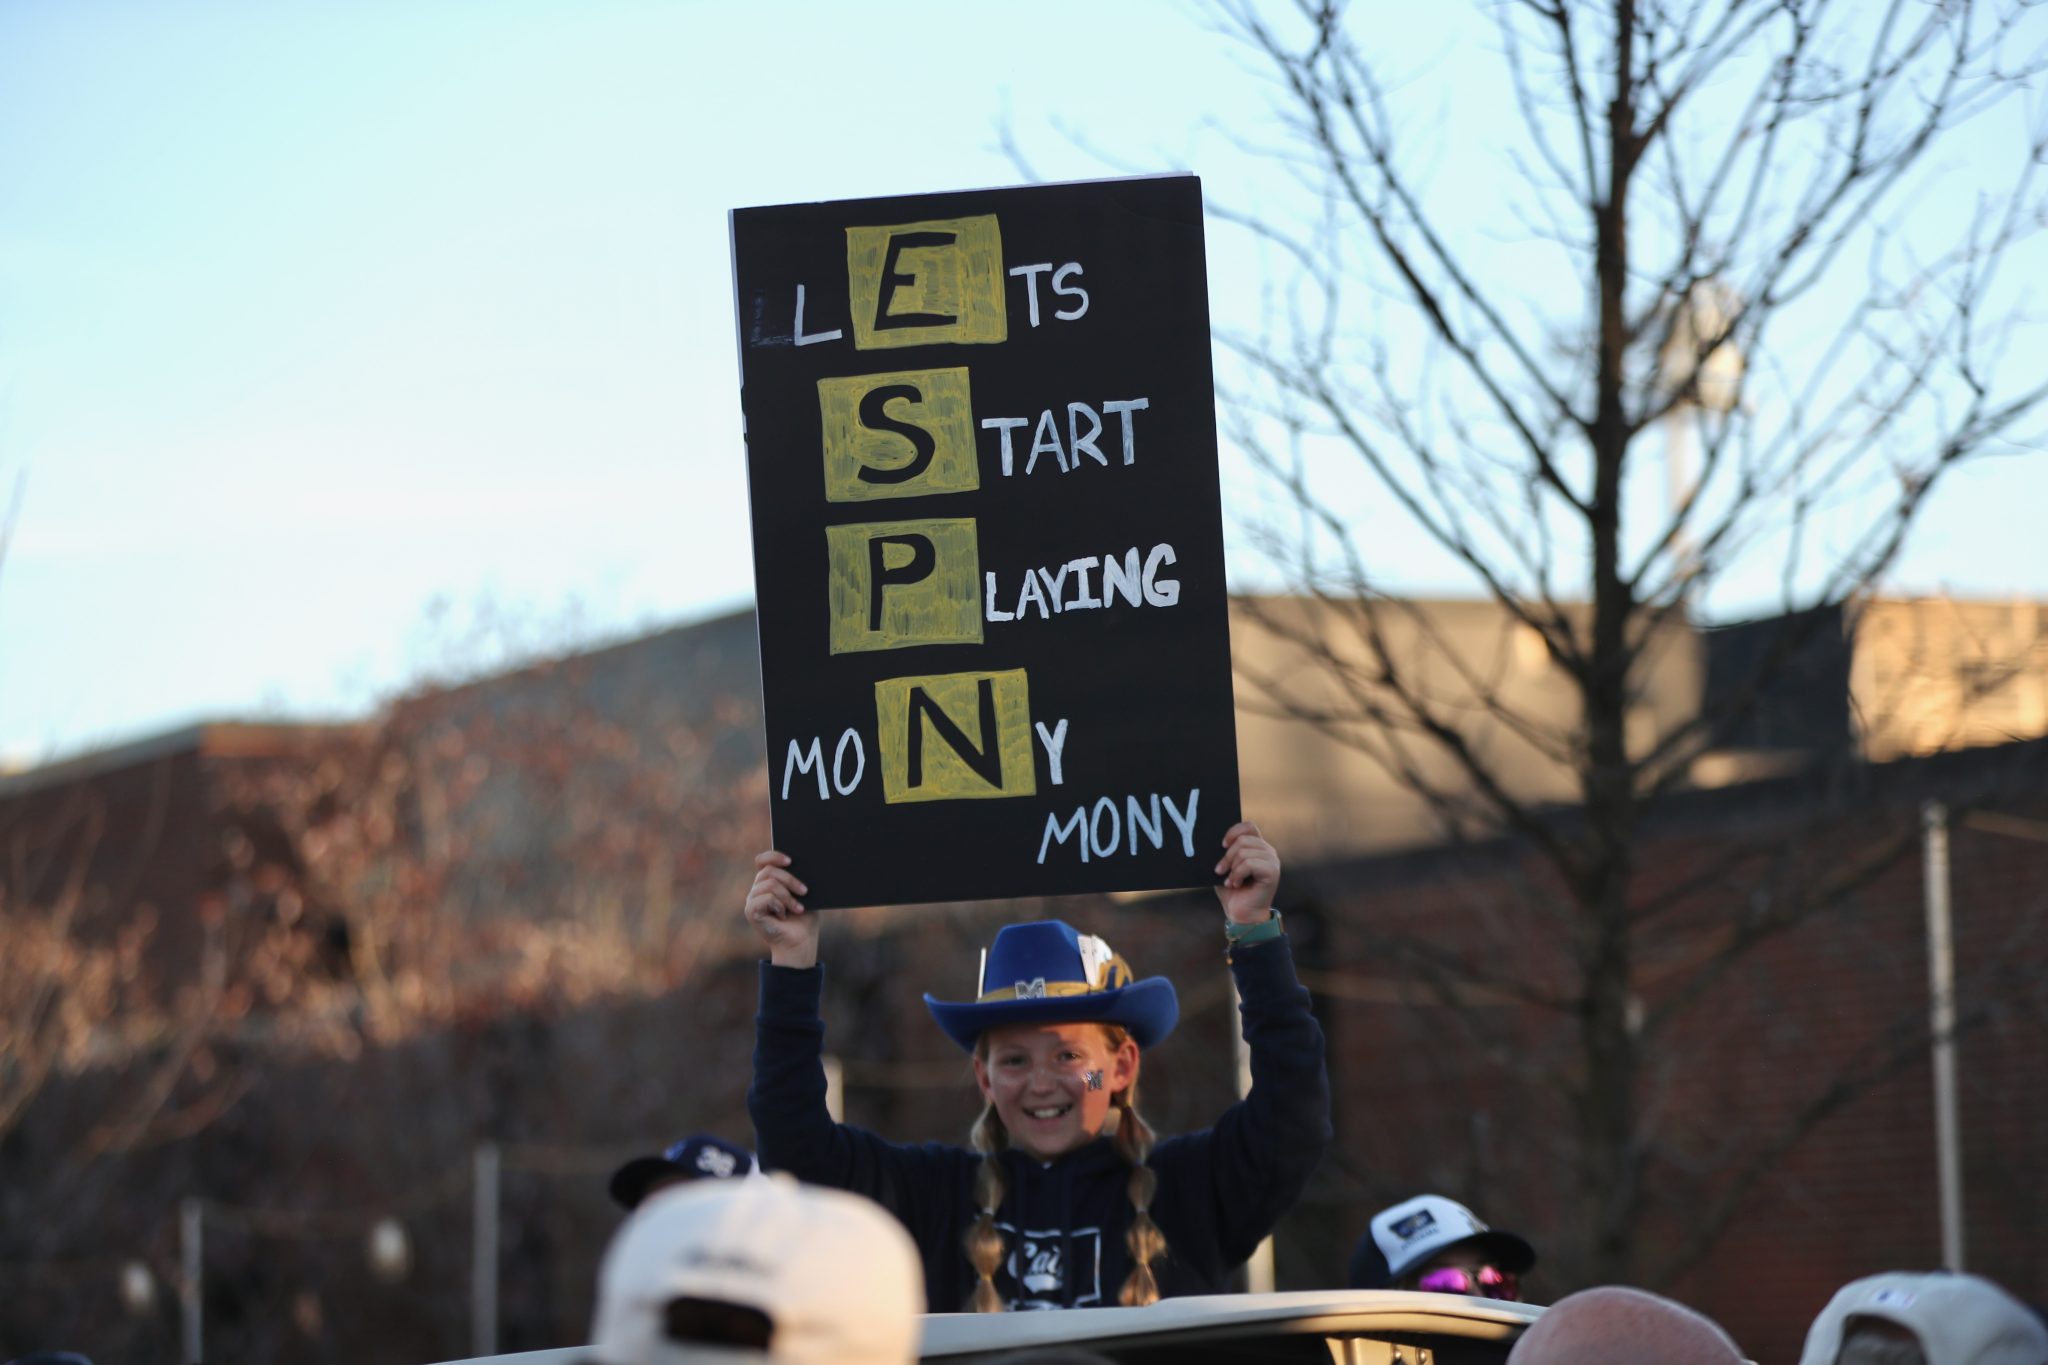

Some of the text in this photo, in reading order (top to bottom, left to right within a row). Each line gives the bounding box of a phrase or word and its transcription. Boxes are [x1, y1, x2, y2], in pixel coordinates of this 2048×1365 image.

[794, 231, 1090, 346] LETS
[857, 384, 1149, 485] START
[868, 533, 1180, 632] PLAYING
[781, 678, 1068, 800] MONY
[1037, 788, 1200, 864] MONY
